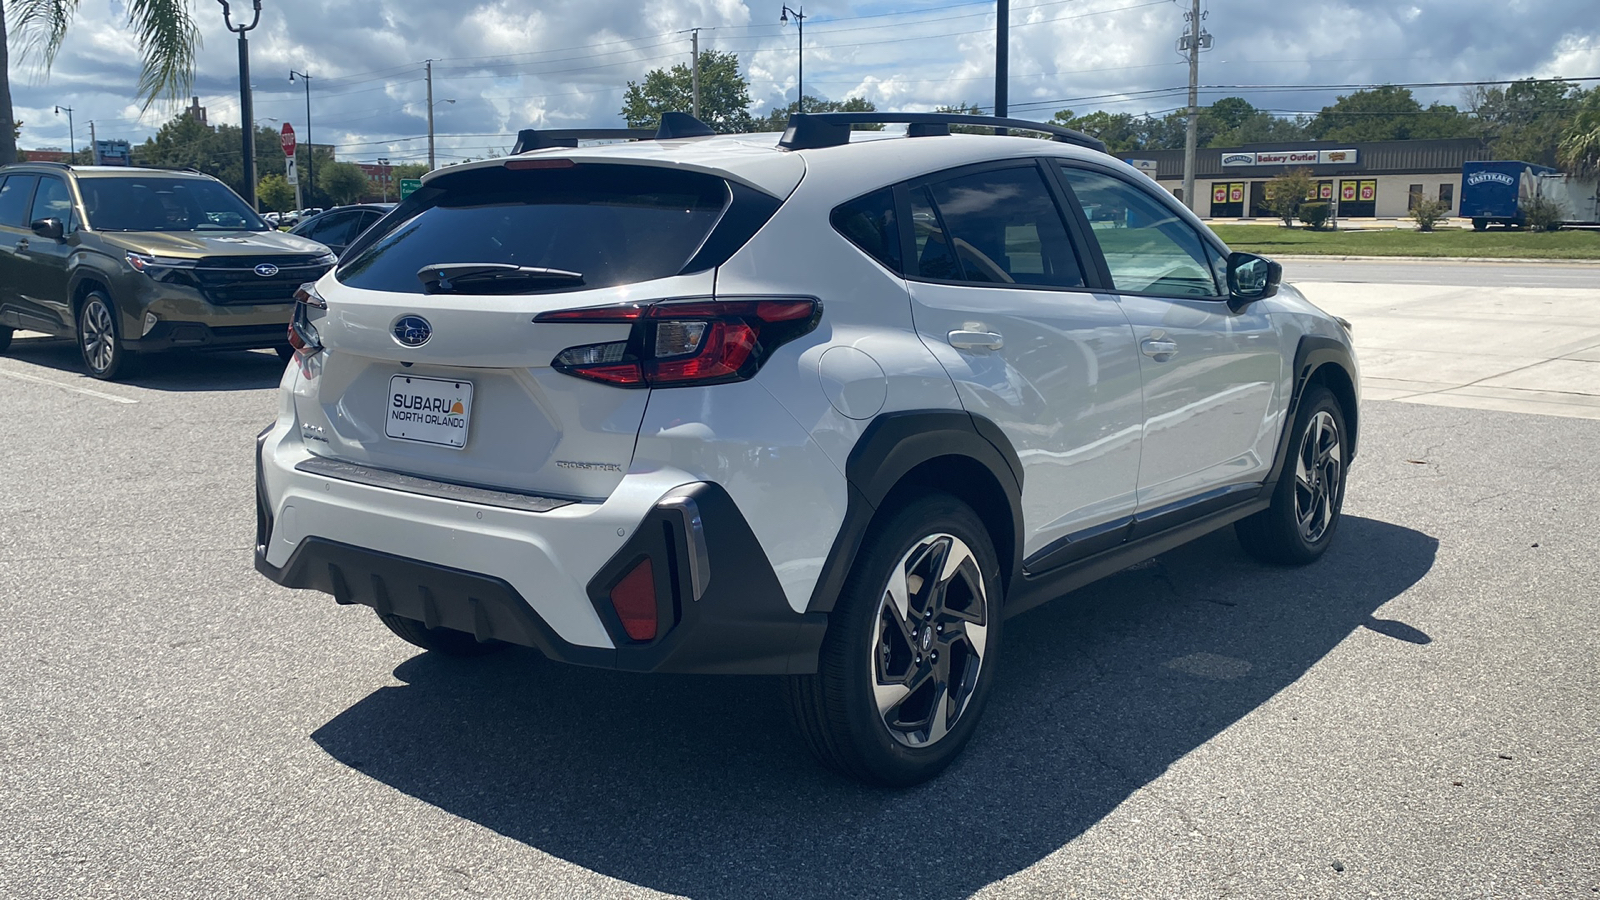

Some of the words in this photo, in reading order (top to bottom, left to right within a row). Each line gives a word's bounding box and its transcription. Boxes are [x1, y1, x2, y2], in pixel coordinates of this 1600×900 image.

[281, 133, 294, 146] STOP
[1257, 154, 1288, 163] Bakery
[1290, 153, 1317, 162] Outlet
[1470, 174, 1512, 184] TASTYKAKE
[393, 394, 452, 413] SUBARU
[392, 410, 424, 422] NORTH
[425, 414, 465, 428] ORLANDO
[556, 461, 622, 472] CROSSTREK
